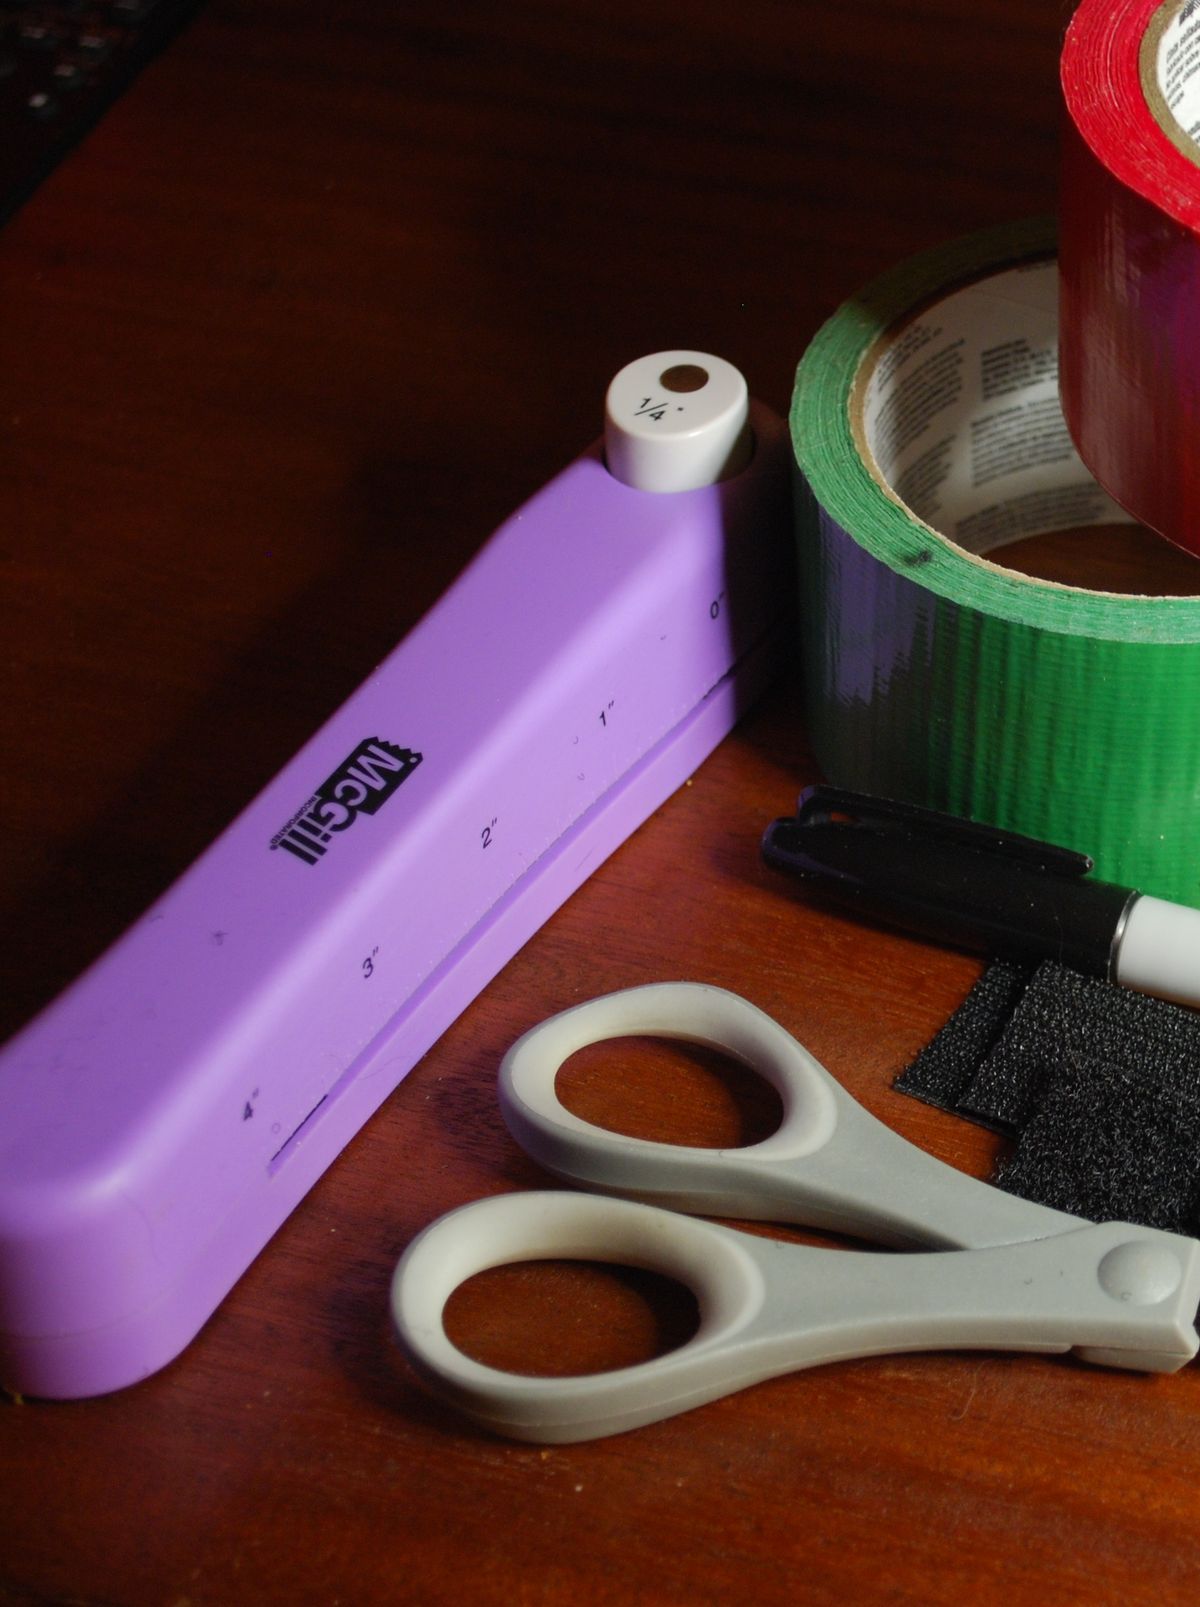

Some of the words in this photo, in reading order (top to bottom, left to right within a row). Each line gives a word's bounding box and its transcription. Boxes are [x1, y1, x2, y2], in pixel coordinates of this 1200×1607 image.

[278, 743, 405, 866] McGill
[481, 816, 498, 849] 2"
[362, 945, 379, 979] 3"
